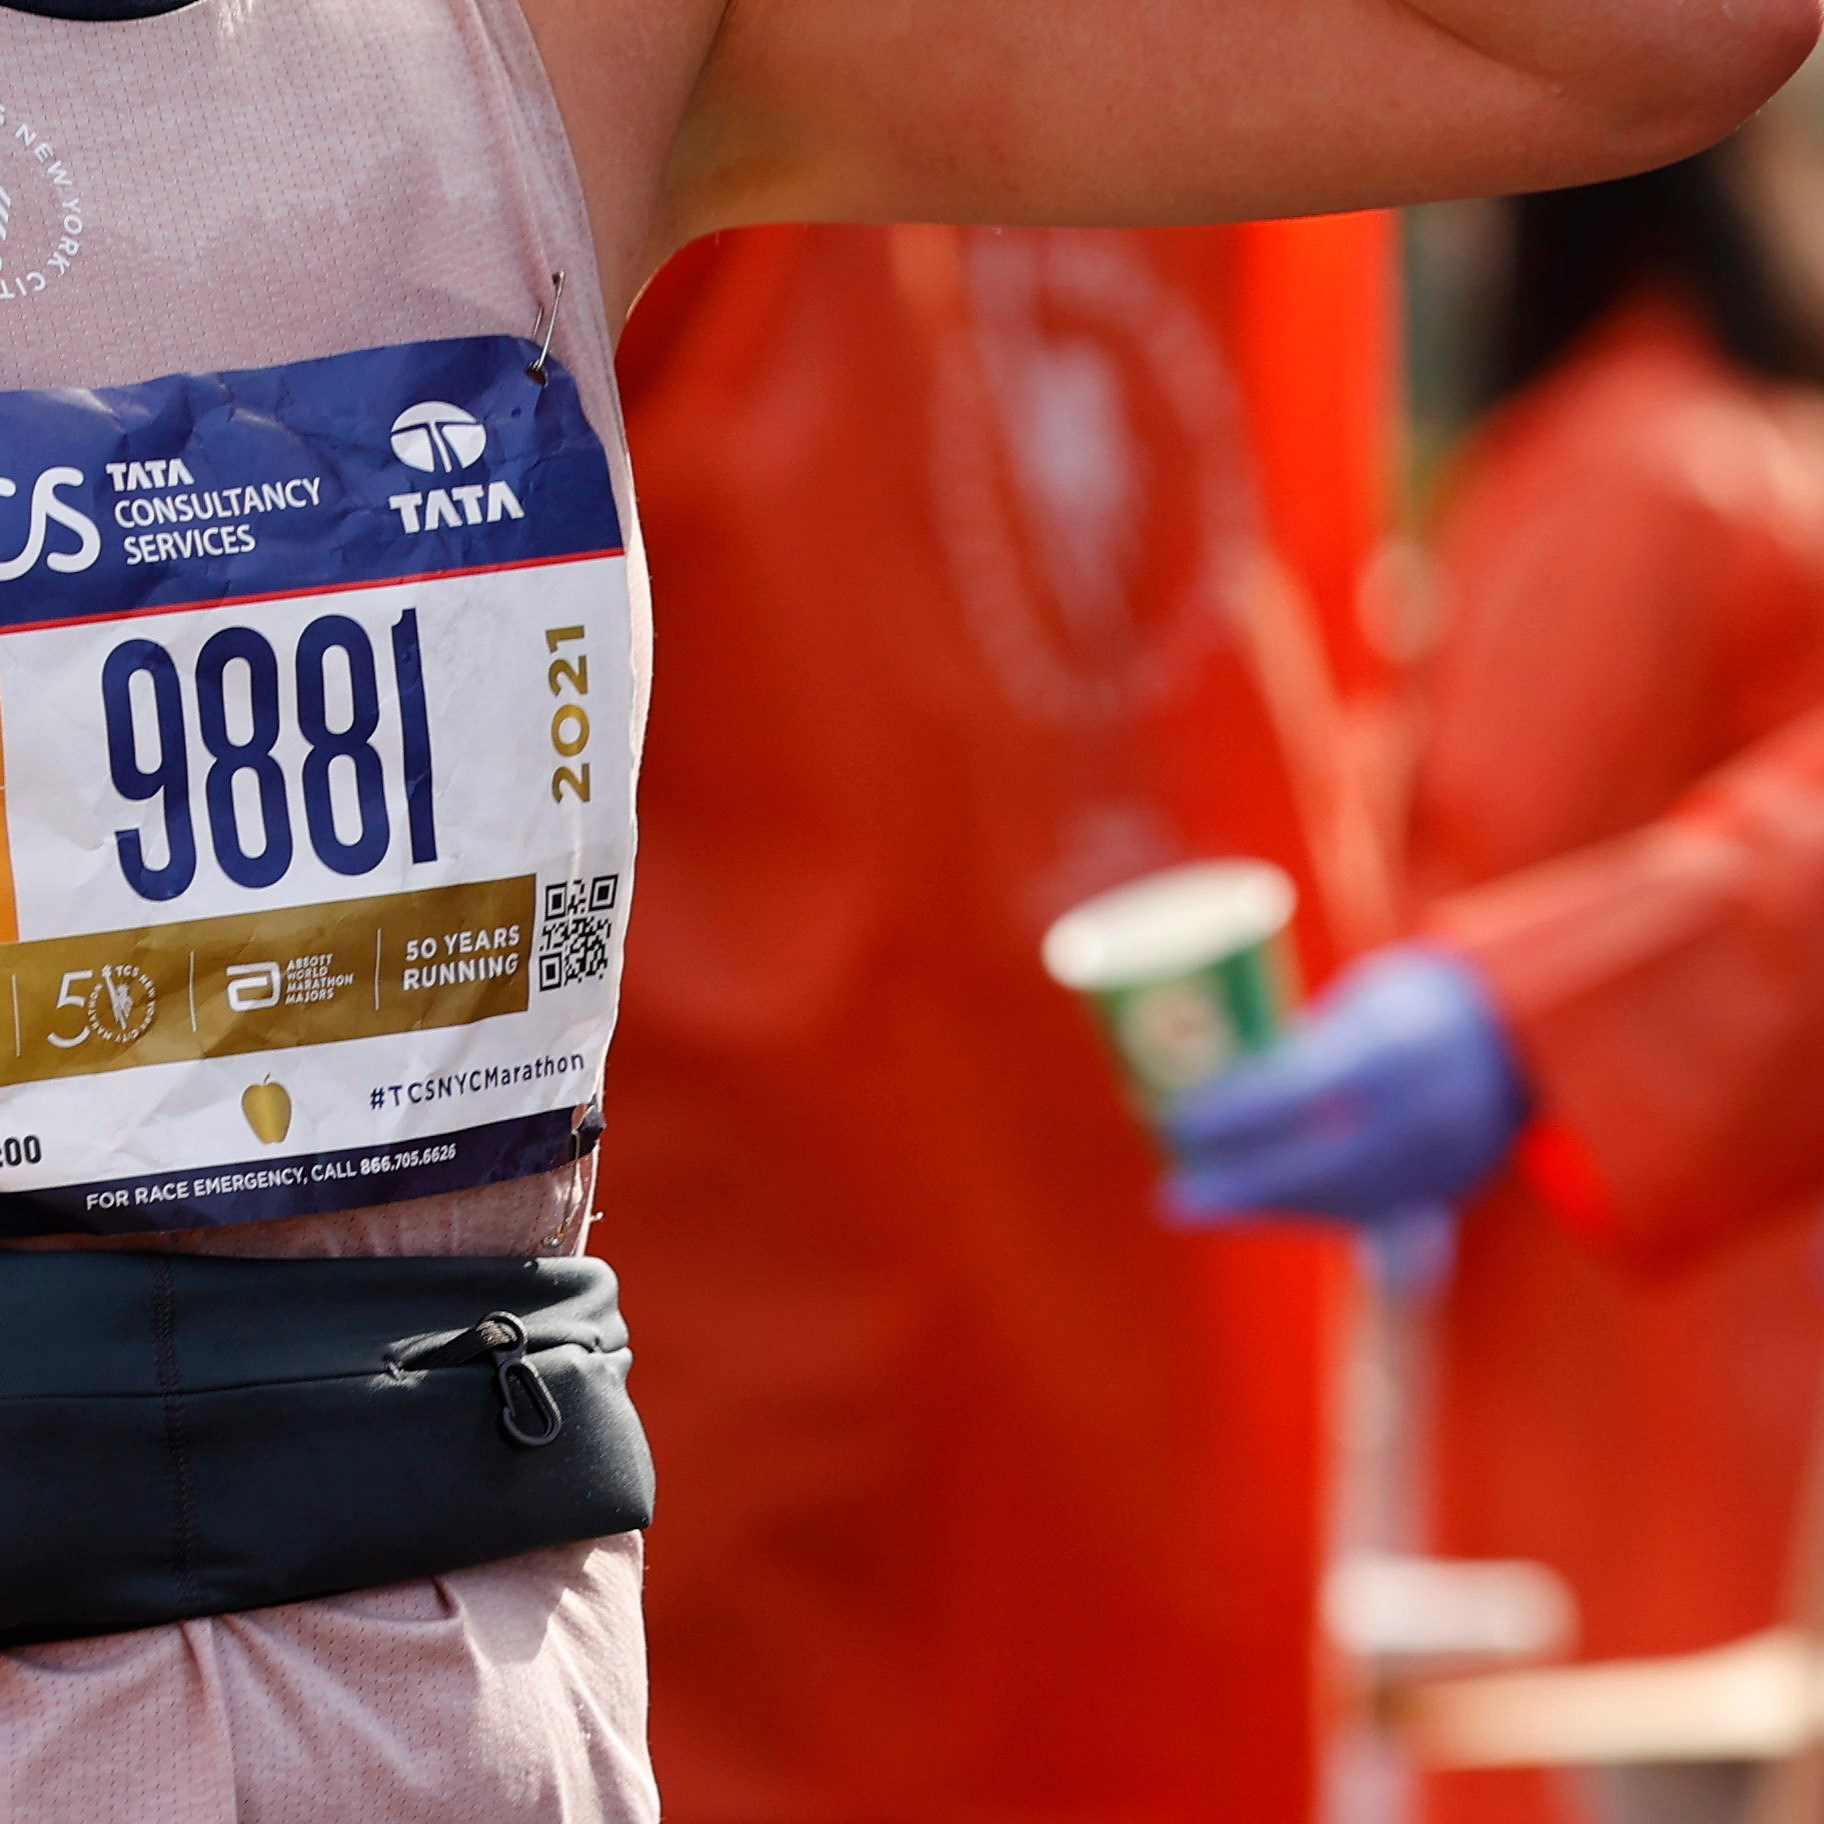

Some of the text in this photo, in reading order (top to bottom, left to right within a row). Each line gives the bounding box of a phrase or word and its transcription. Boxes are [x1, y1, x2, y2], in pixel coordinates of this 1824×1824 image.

[15, 124, 73, 187] NEW
[47, 198, 83, 275] YORK
[106, 458, 194, 492] TATA
[113, 477, 321, 529] CONSULTANCY
[389, 481, 524, 535] TATA
[124, 524, 256, 566] SERVICES
[545, 624, 591, 804] 2021
[101, 607, 438, 901] 9881
[287, 953, 333, 970] ABBOTT
[405, 925, 520, 962] 50 YEARS
[115, 964, 140, 977] TCS
[286, 973, 354, 993] MARATHON
[287, 966, 328, 982] WORLD
[403, 953, 519, 991] RUNNING
[285, 987, 334, 1005] MAJORS
[370, 1052, 585, 1110] #TCSNYCMarathon
[86, 1143, 456, 1211] FOR RACE EMERGENCY, CALL 866.705.6626
